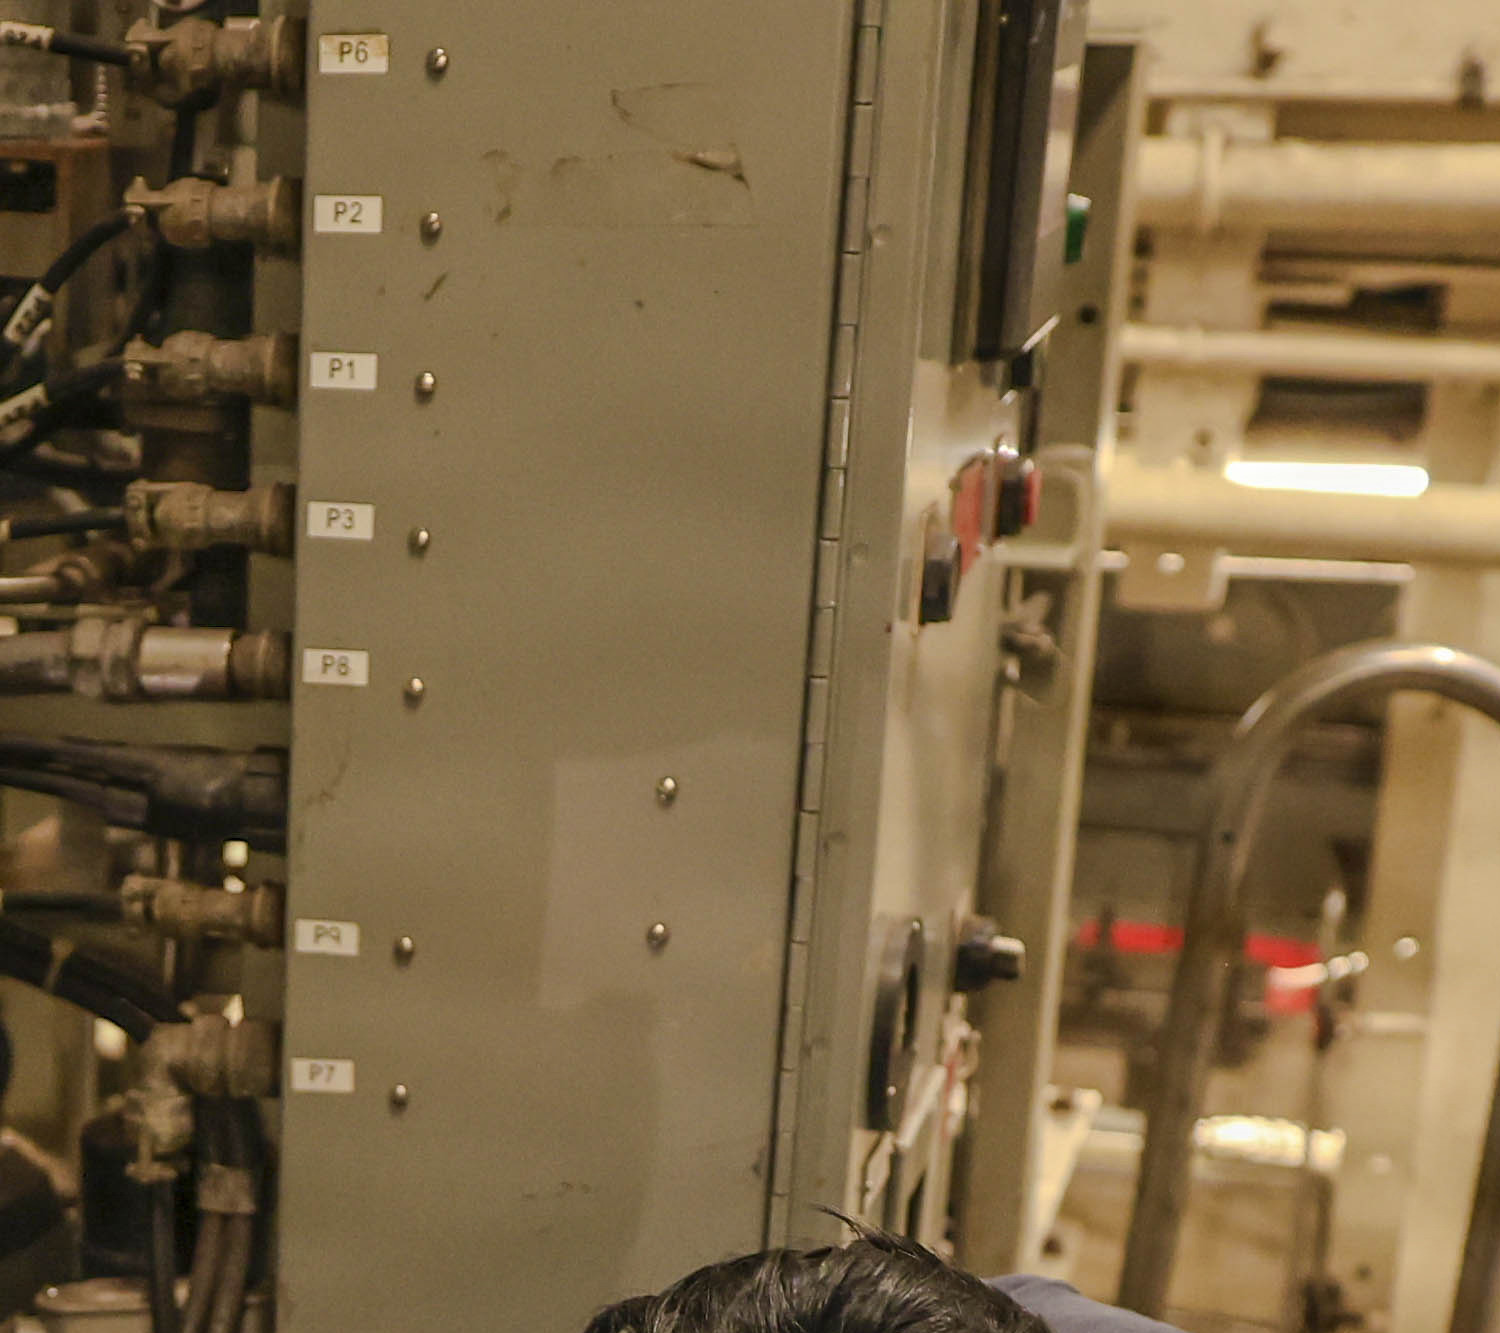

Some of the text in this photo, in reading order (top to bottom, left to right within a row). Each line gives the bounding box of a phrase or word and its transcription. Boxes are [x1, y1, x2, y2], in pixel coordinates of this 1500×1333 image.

[337, 40, 369, 65] P6
[333, 201, 363, 224] P2
[328, 358, 356, 381] P1
[325, 508, 356, 531] P3
[312, 925, 342, 946] P9
[308, 1064, 336, 1084] P7
